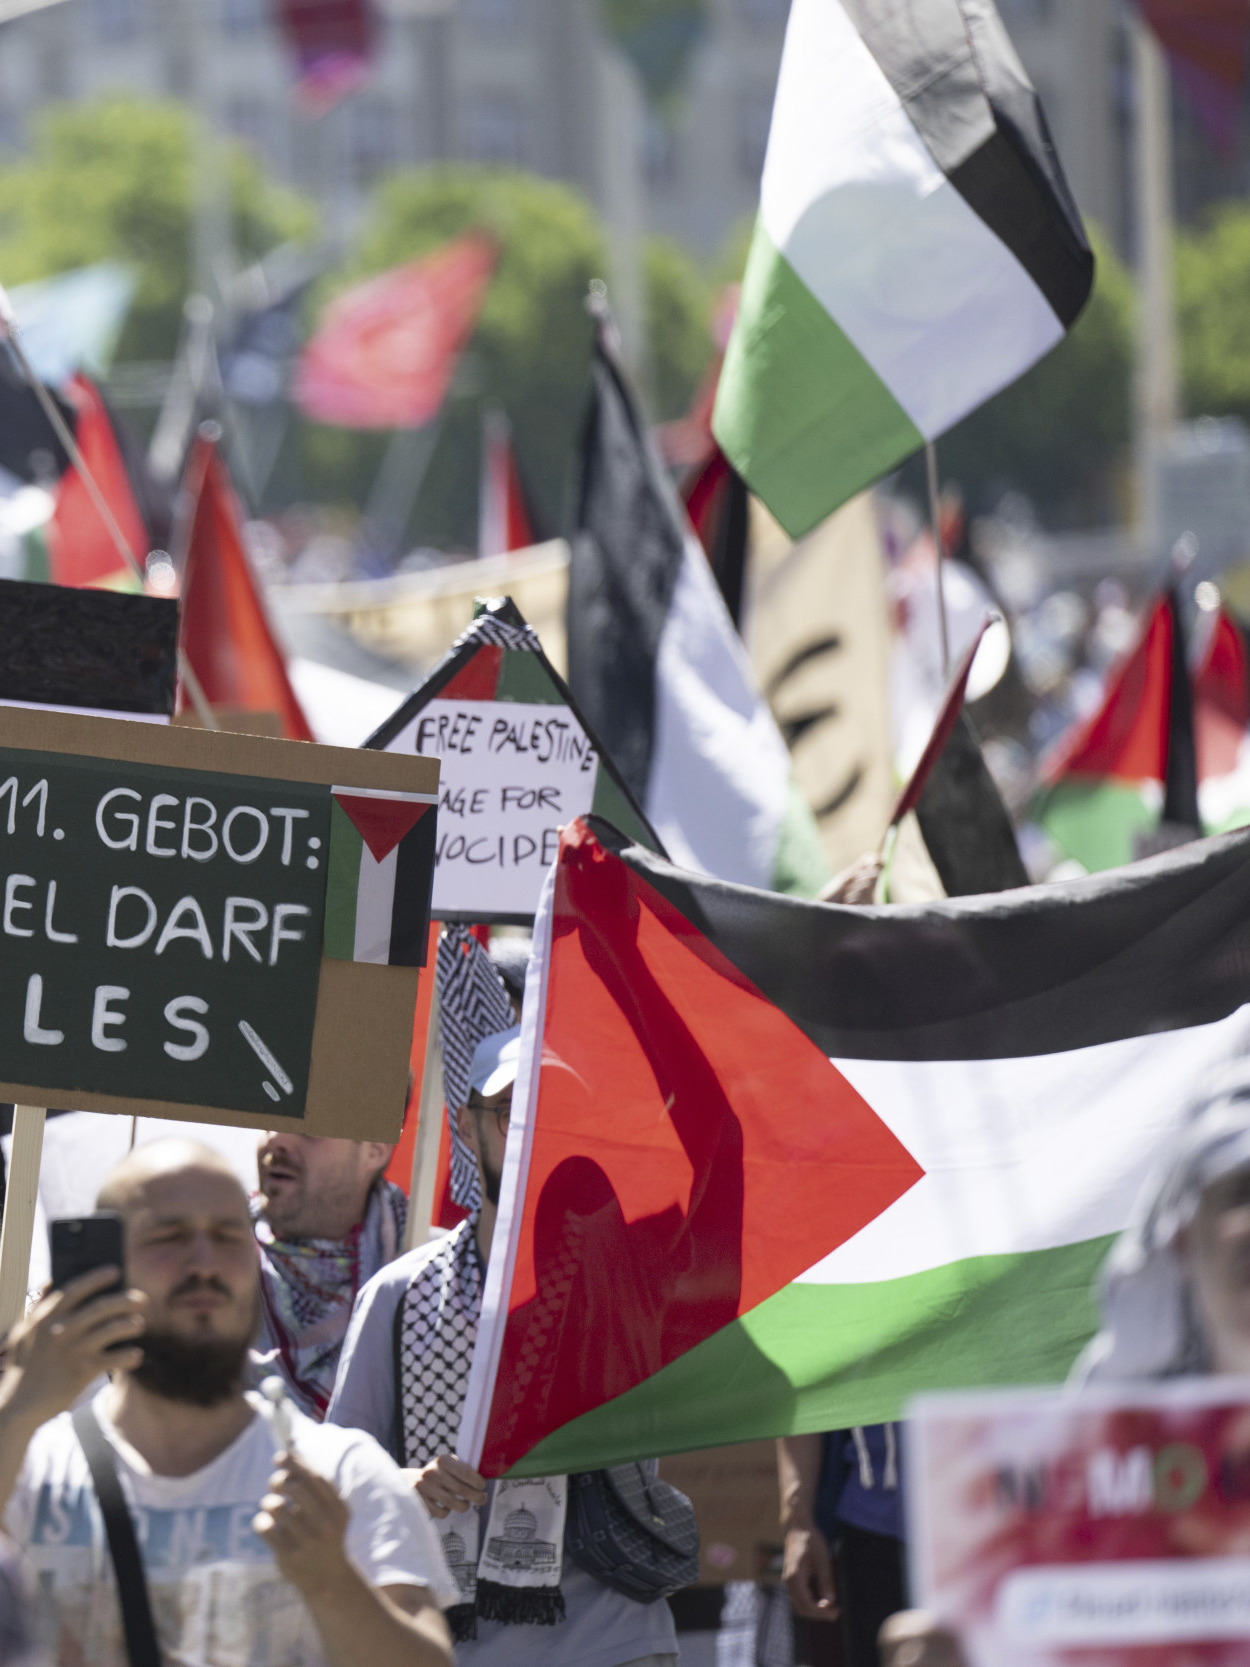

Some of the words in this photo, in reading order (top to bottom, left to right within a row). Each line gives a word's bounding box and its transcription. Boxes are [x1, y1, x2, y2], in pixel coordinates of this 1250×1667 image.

[415, 711, 483, 754] FREE
[488, 718, 595, 772] PALESTINE
[95, 787, 321, 870] GEBOT:
[437, 780, 490, 818] AGE
[501, 786, 562, 813] FOR
[106, 885, 312, 966] DARF
